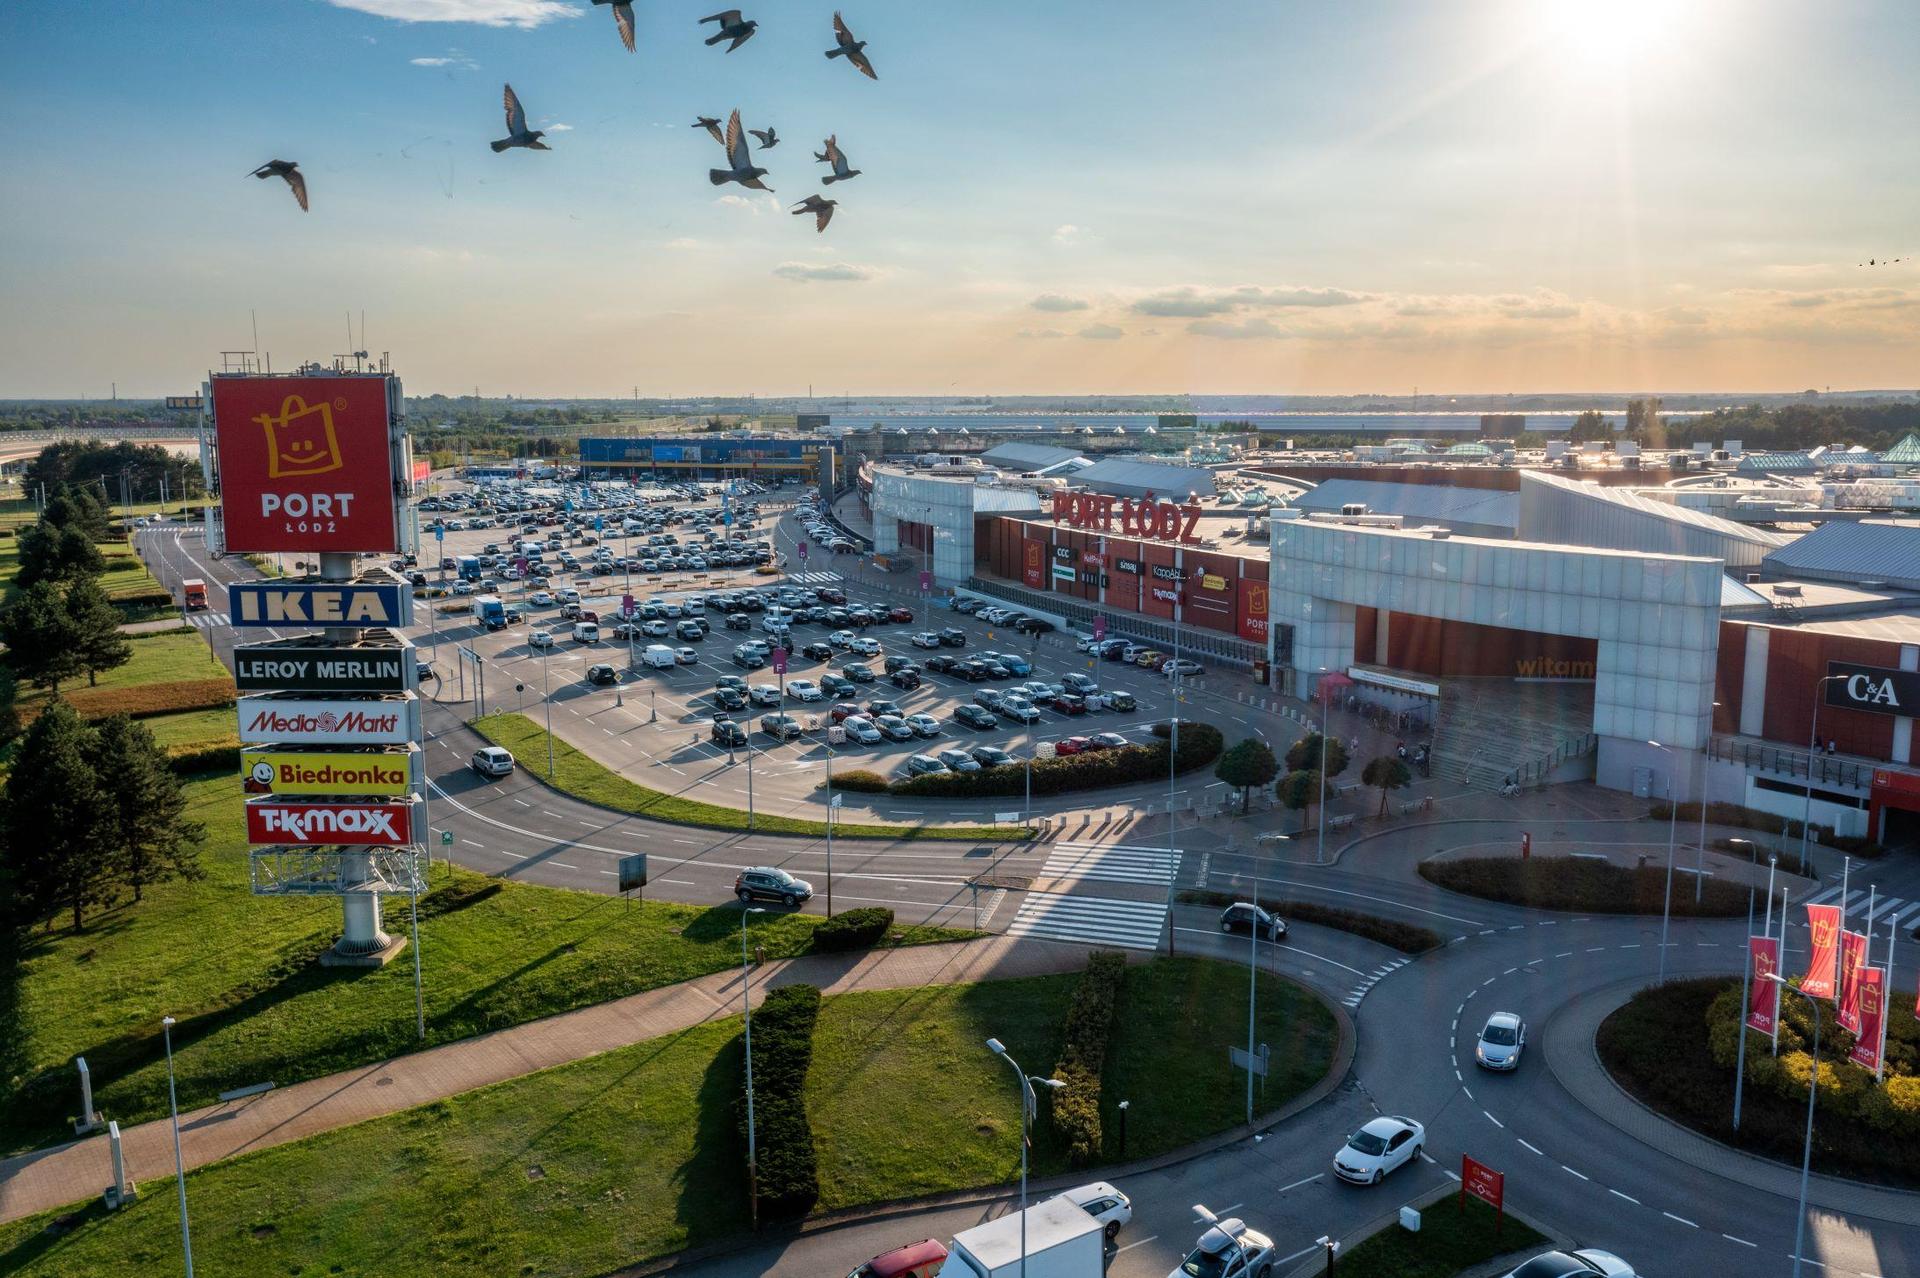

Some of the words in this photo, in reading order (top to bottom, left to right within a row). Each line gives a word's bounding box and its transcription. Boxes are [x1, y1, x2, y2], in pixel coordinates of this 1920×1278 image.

[261, 493, 354, 517] PORT
[286, 521, 336, 533] ŁÓDŹ
[1053, 489, 1117, 531] PORT
[1121, 490, 1202, 546] ŁÓDŹ
[1057, 547, 1069, 558] CCC
[241, 591, 389, 621] IKEA
[239, 661, 308, 678] LEROY
[317, 661, 399, 678] MERLIN
[776, 663, 783, 673] F
[1516, 656, 1594, 675] witam
[1847, 674, 1900, 706] C&A
[279, 764, 404, 785] Biedronka
